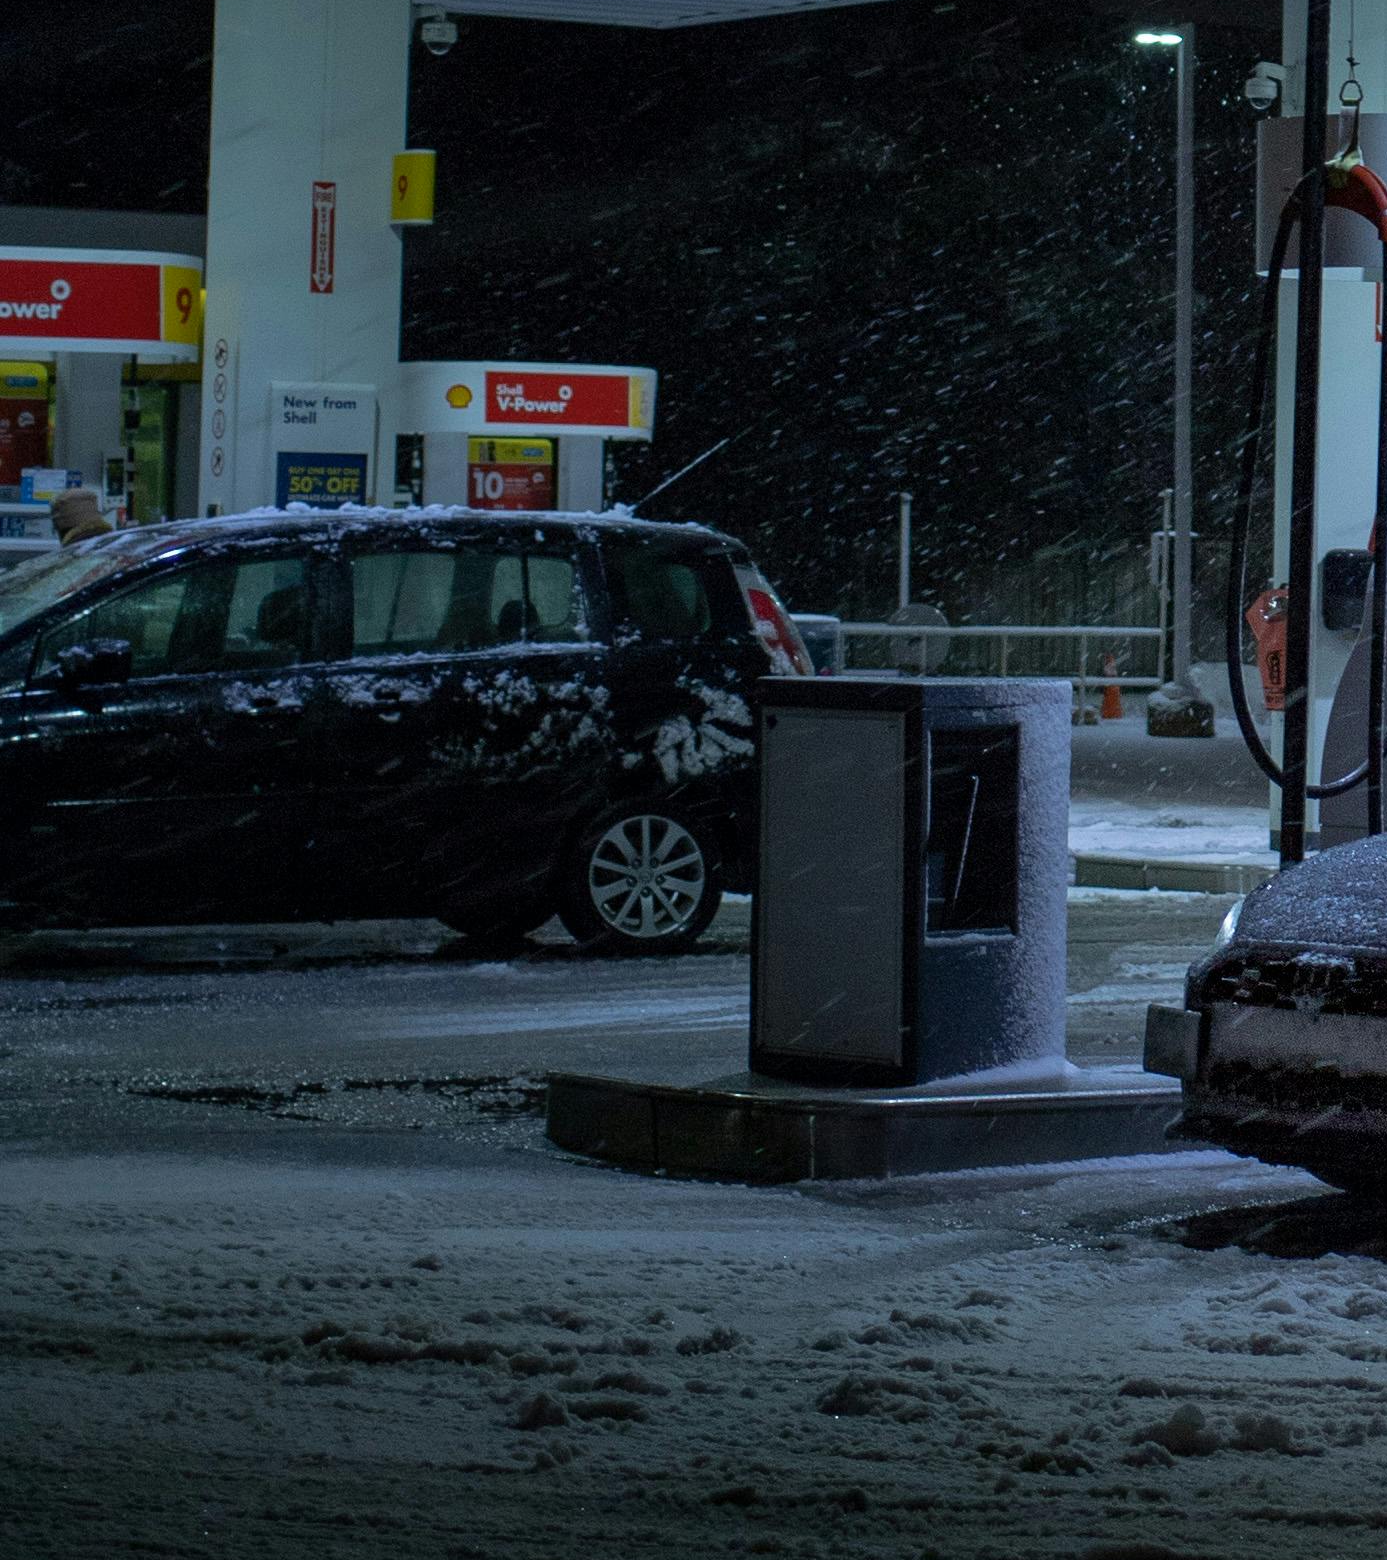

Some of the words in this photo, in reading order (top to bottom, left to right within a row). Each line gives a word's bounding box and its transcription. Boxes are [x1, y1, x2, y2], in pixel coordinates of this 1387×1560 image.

[398, 175, 408, 200] 9
[176, 287, 193, 324] 9
[496, 384, 523, 396] Shell
[283, 396, 316, 408] New
[324, 396, 357, 409] from
[497, 397, 568, 414] V-Power
[283, 411, 317, 424] Shell
[326, 477, 360, 494] OFF
[473, 471, 504, 500] 10
